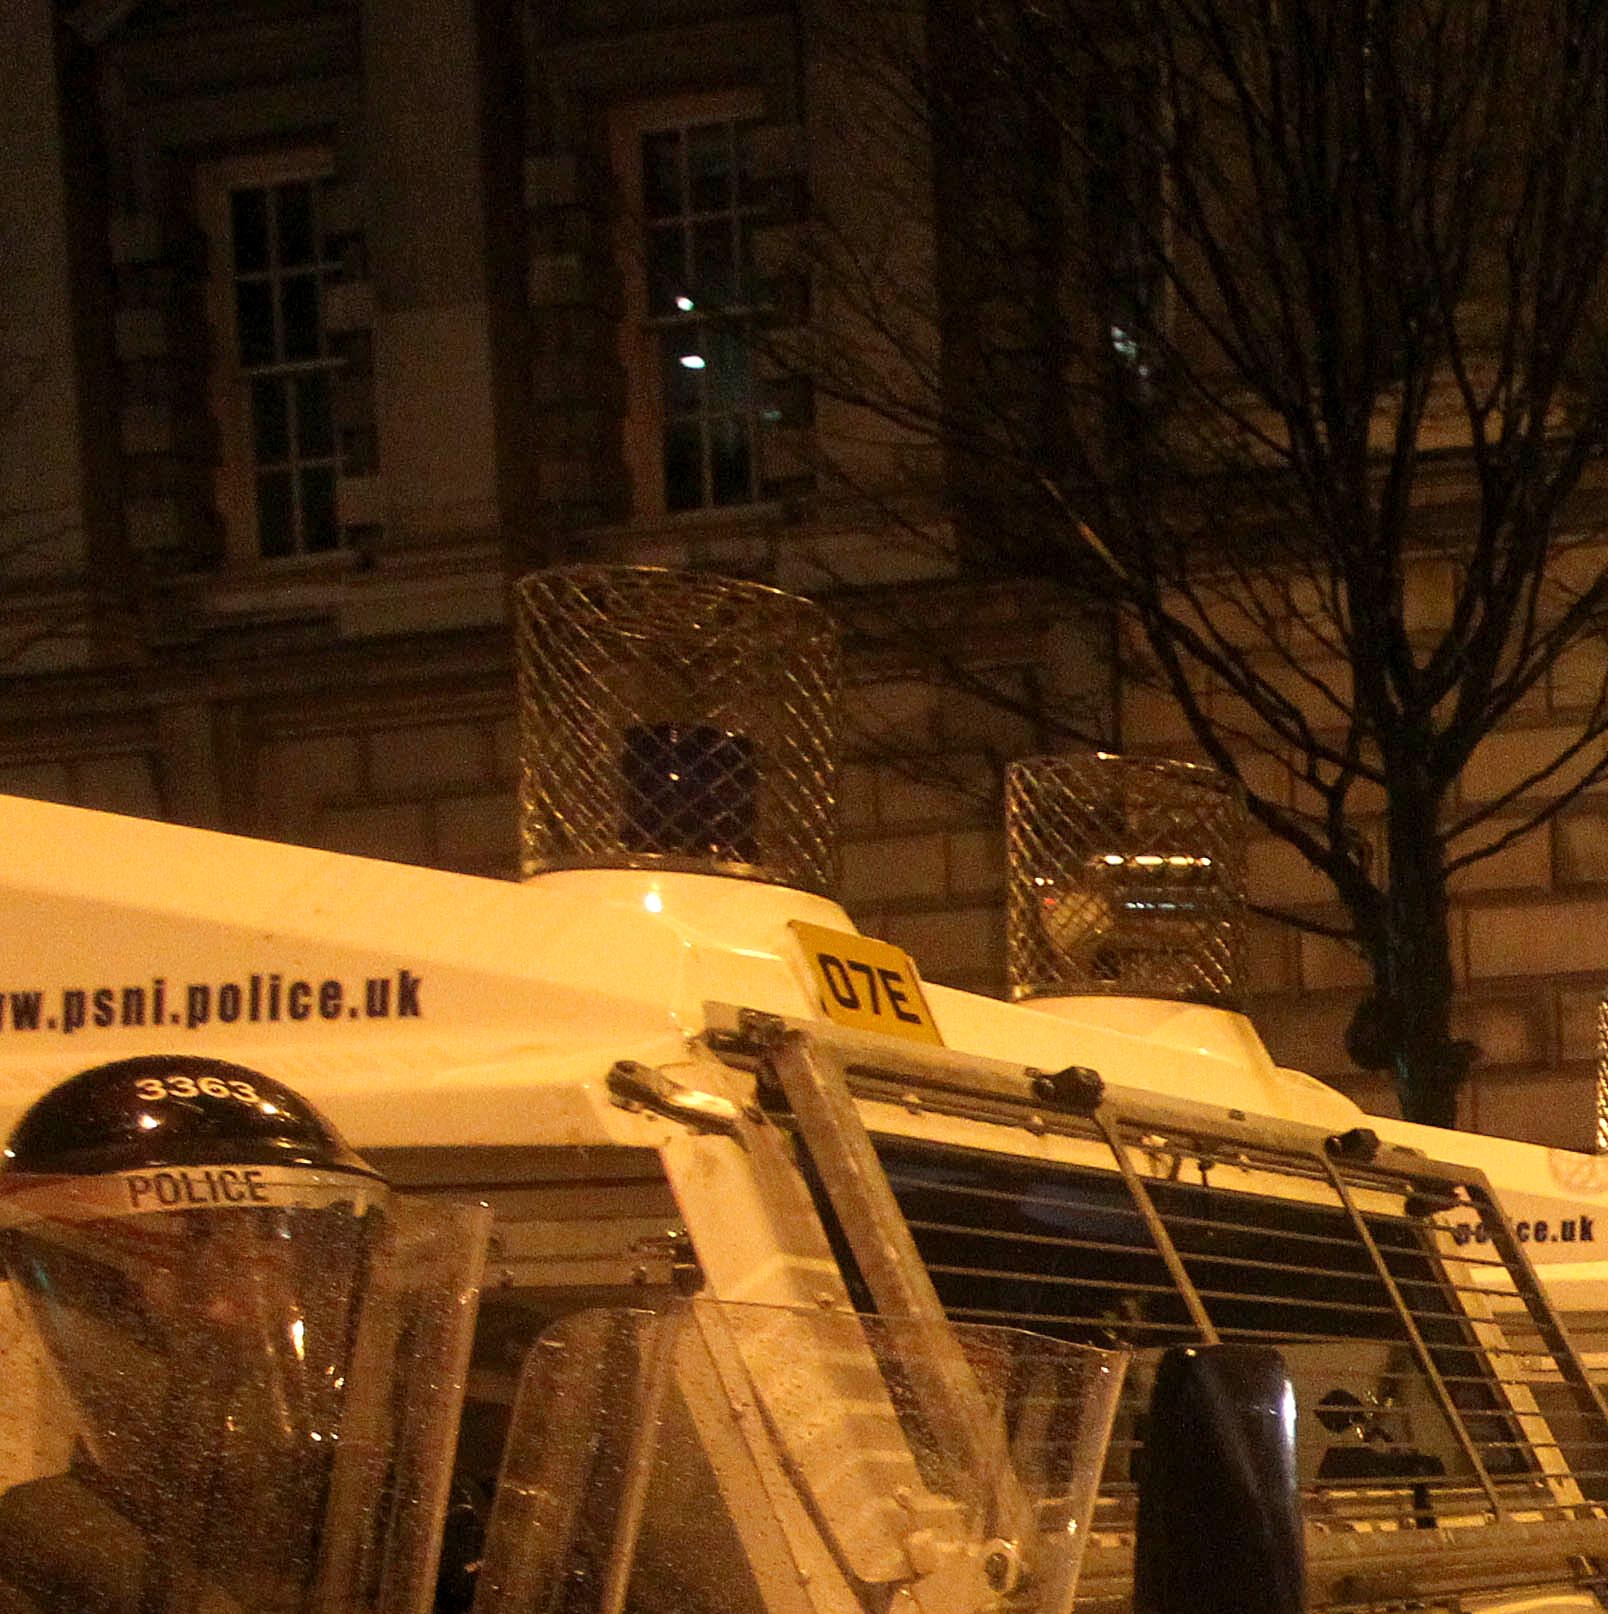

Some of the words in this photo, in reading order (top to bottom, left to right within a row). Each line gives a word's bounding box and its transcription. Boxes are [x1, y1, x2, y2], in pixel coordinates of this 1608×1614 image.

[0, 969, 421, 1034] w.psni.police.uk
[819, 953, 922, 1025] 07E
[134, 1076, 260, 1103] 3363
[126, 1170, 270, 1208] POLICE
